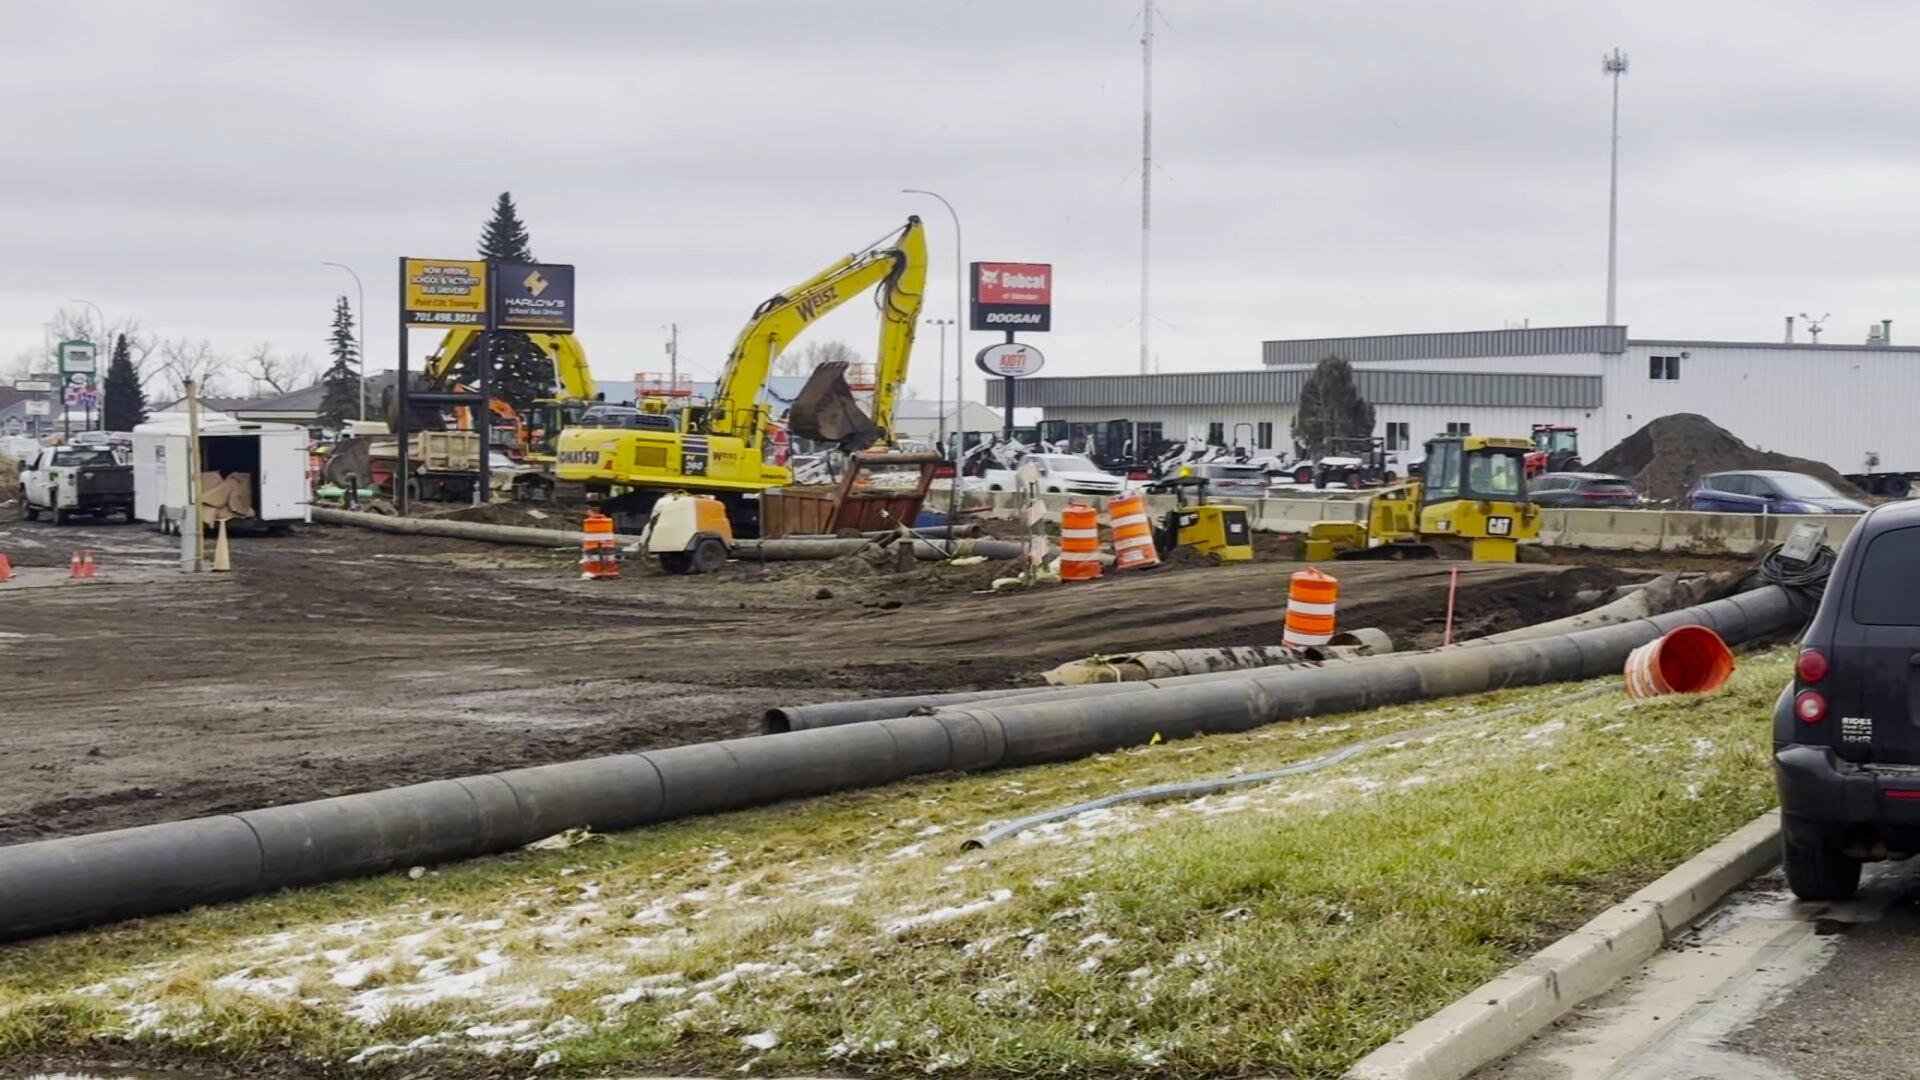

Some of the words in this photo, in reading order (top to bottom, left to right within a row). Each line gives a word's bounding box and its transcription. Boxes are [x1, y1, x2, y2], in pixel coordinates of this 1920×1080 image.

[1002, 272, 1045, 289] Bobcat
[504, 298, 566, 308] HARLOW'S
[986, 313, 1042, 324] DOOSAN
[1489, 517, 1510, 534] CAT
[1842, 717, 1872, 725] RIDES
